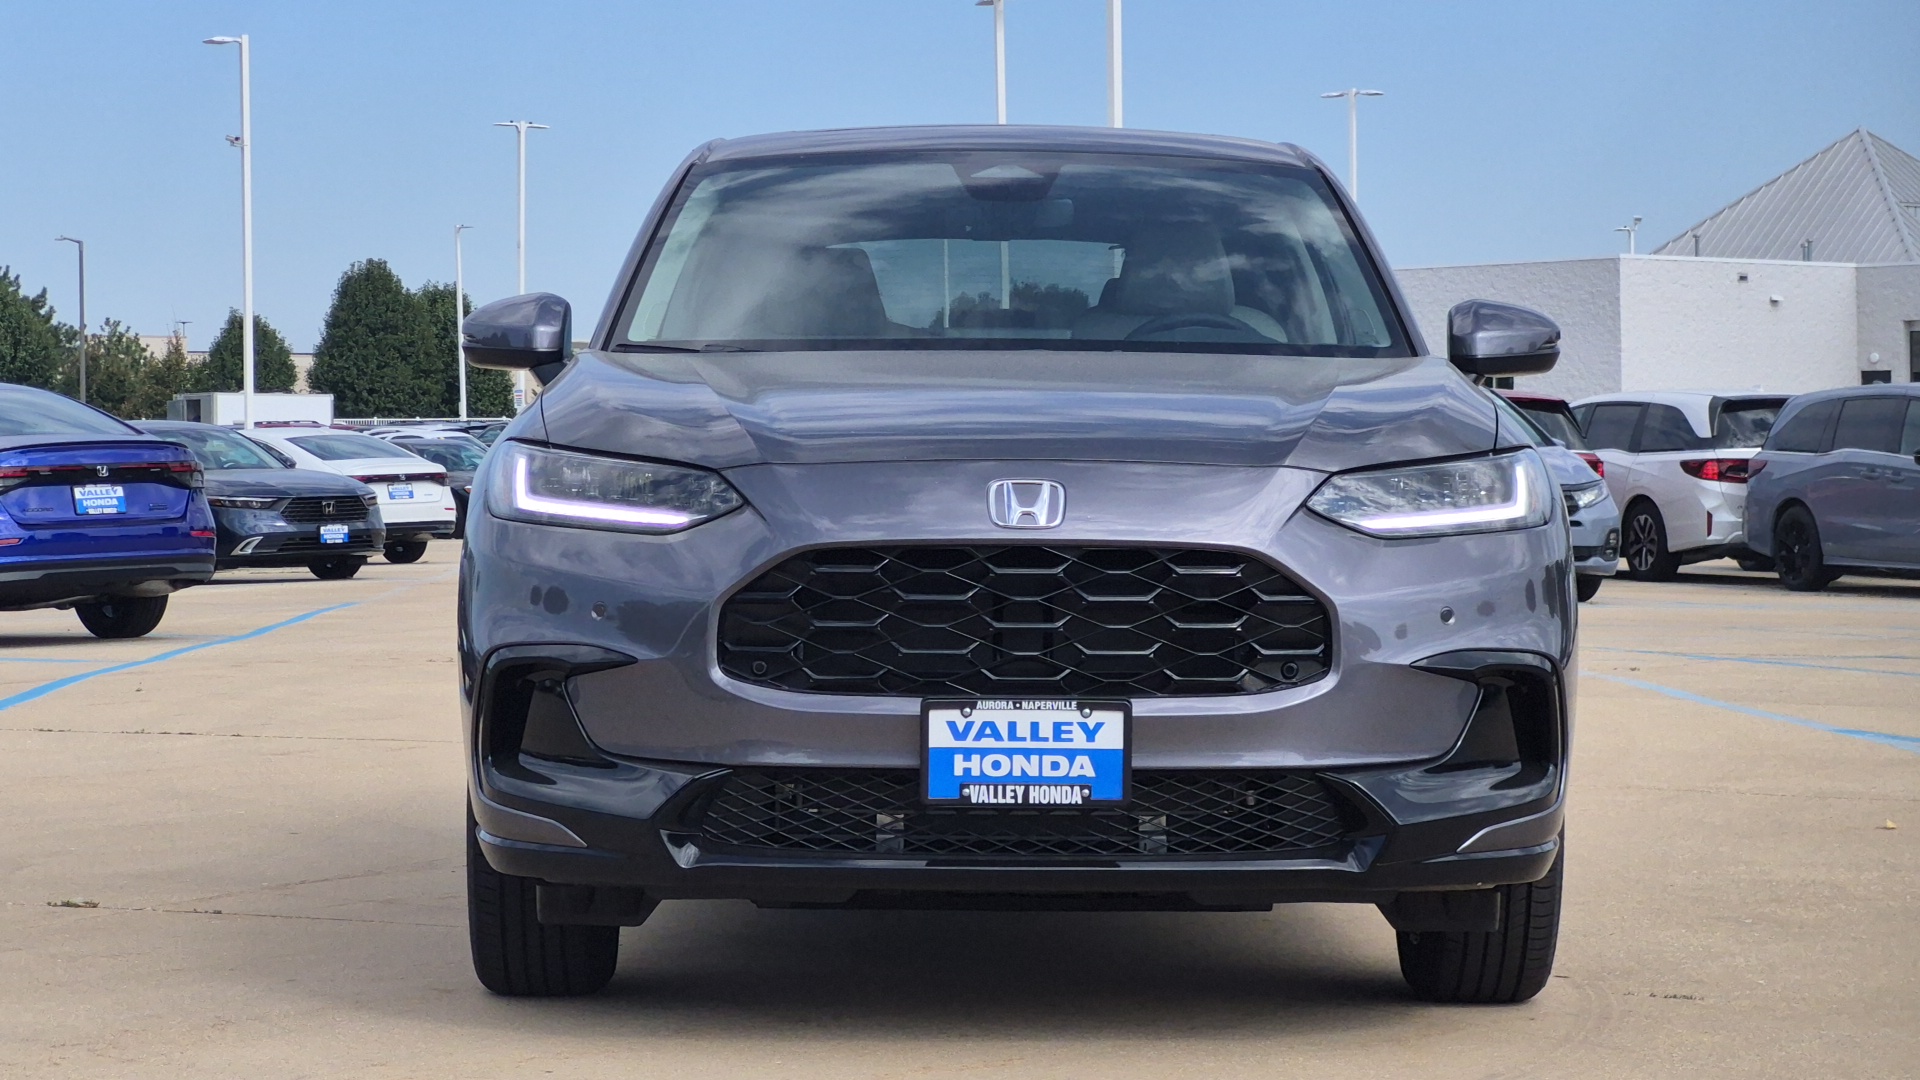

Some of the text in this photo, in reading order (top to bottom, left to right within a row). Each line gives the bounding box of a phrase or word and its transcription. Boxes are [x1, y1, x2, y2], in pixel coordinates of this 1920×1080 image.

[79, 489, 118, 497] VALLEY
[82, 498, 118, 507] HONDA
[976, 701, 1078, 711] AURORA NAPERVILLE
[945, 720, 1106, 743] VALLEY
[953, 754, 1096, 778] HONDA
[969, 785, 1083, 805] VALLEY HONDA
